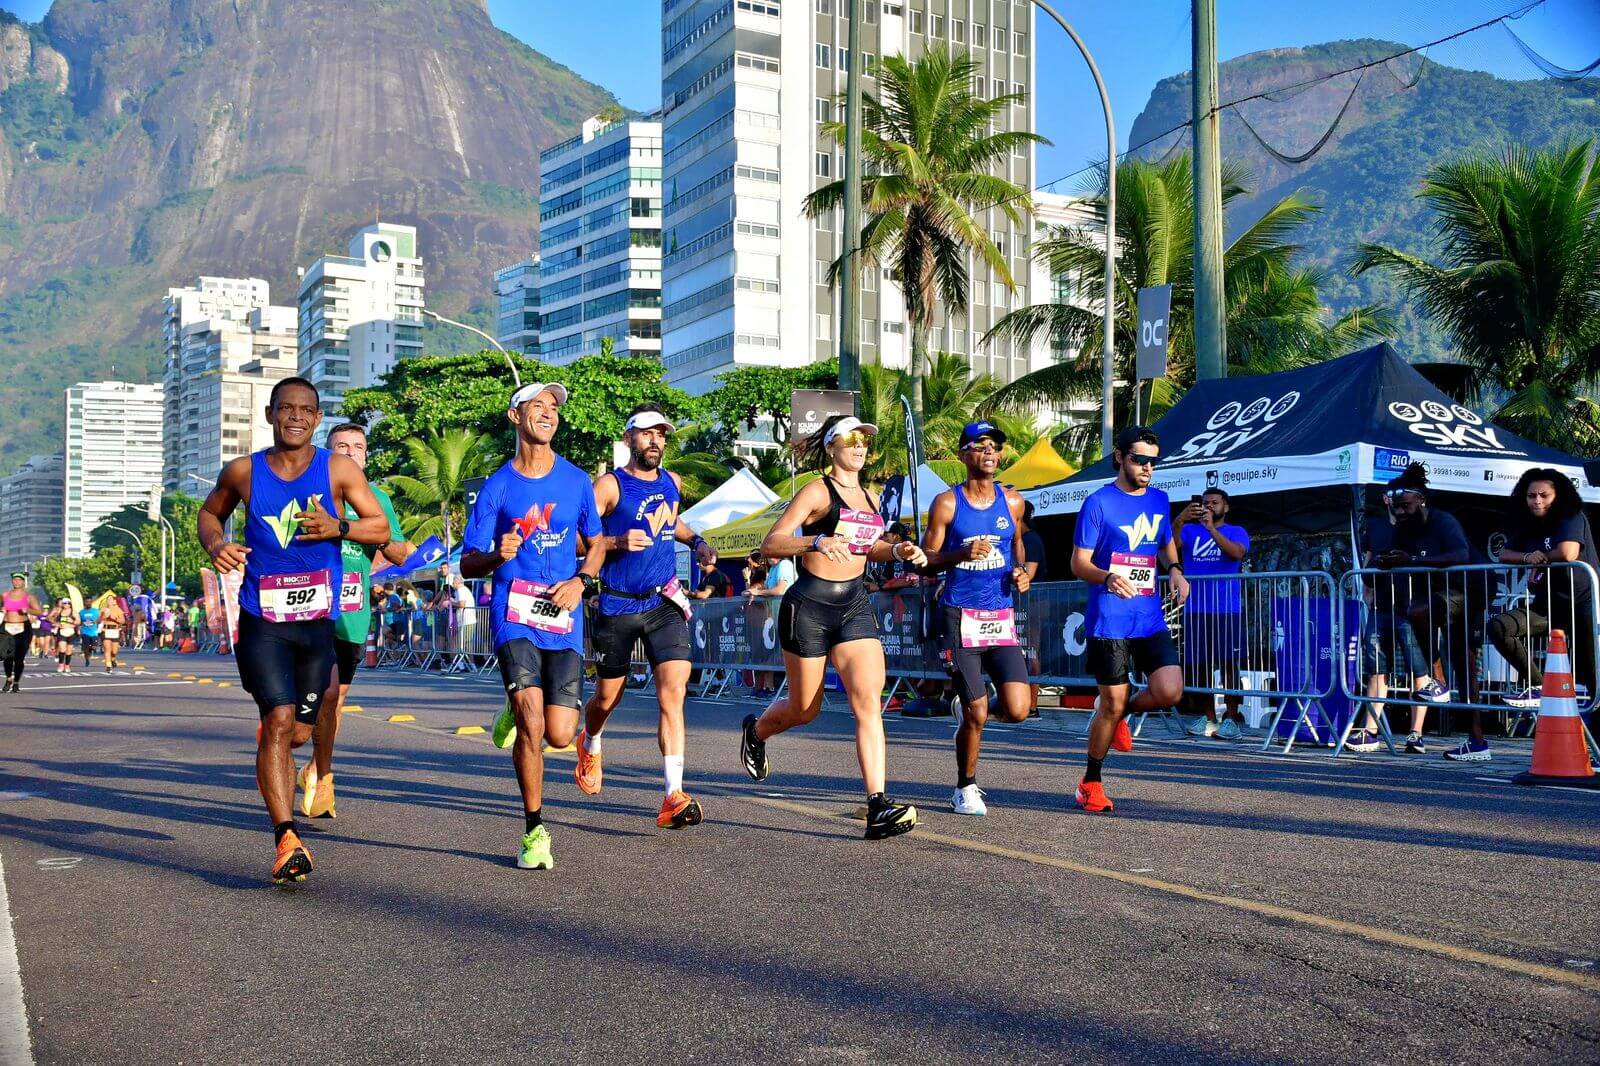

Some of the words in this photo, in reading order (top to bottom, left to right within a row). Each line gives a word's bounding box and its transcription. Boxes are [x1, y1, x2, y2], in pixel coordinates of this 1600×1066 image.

[1162, 422, 1277, 462] SKY
[1408, 422, 1506, 449] SKY
[1390, 454, 1408, 466] RIO
[1222, 465, 1278, 485] @equipe.sky
[1432, 467, 1470, 478] 99981-9990
[854, 526, 877, 540] 582
[1128, 568, 1151, 582] 586
[286, 587, 317, 606] 592
[530, 600, 561, 618] 589
[979, 622, 1003, 635] 590
[879, 634, 901, 645] GUANA
